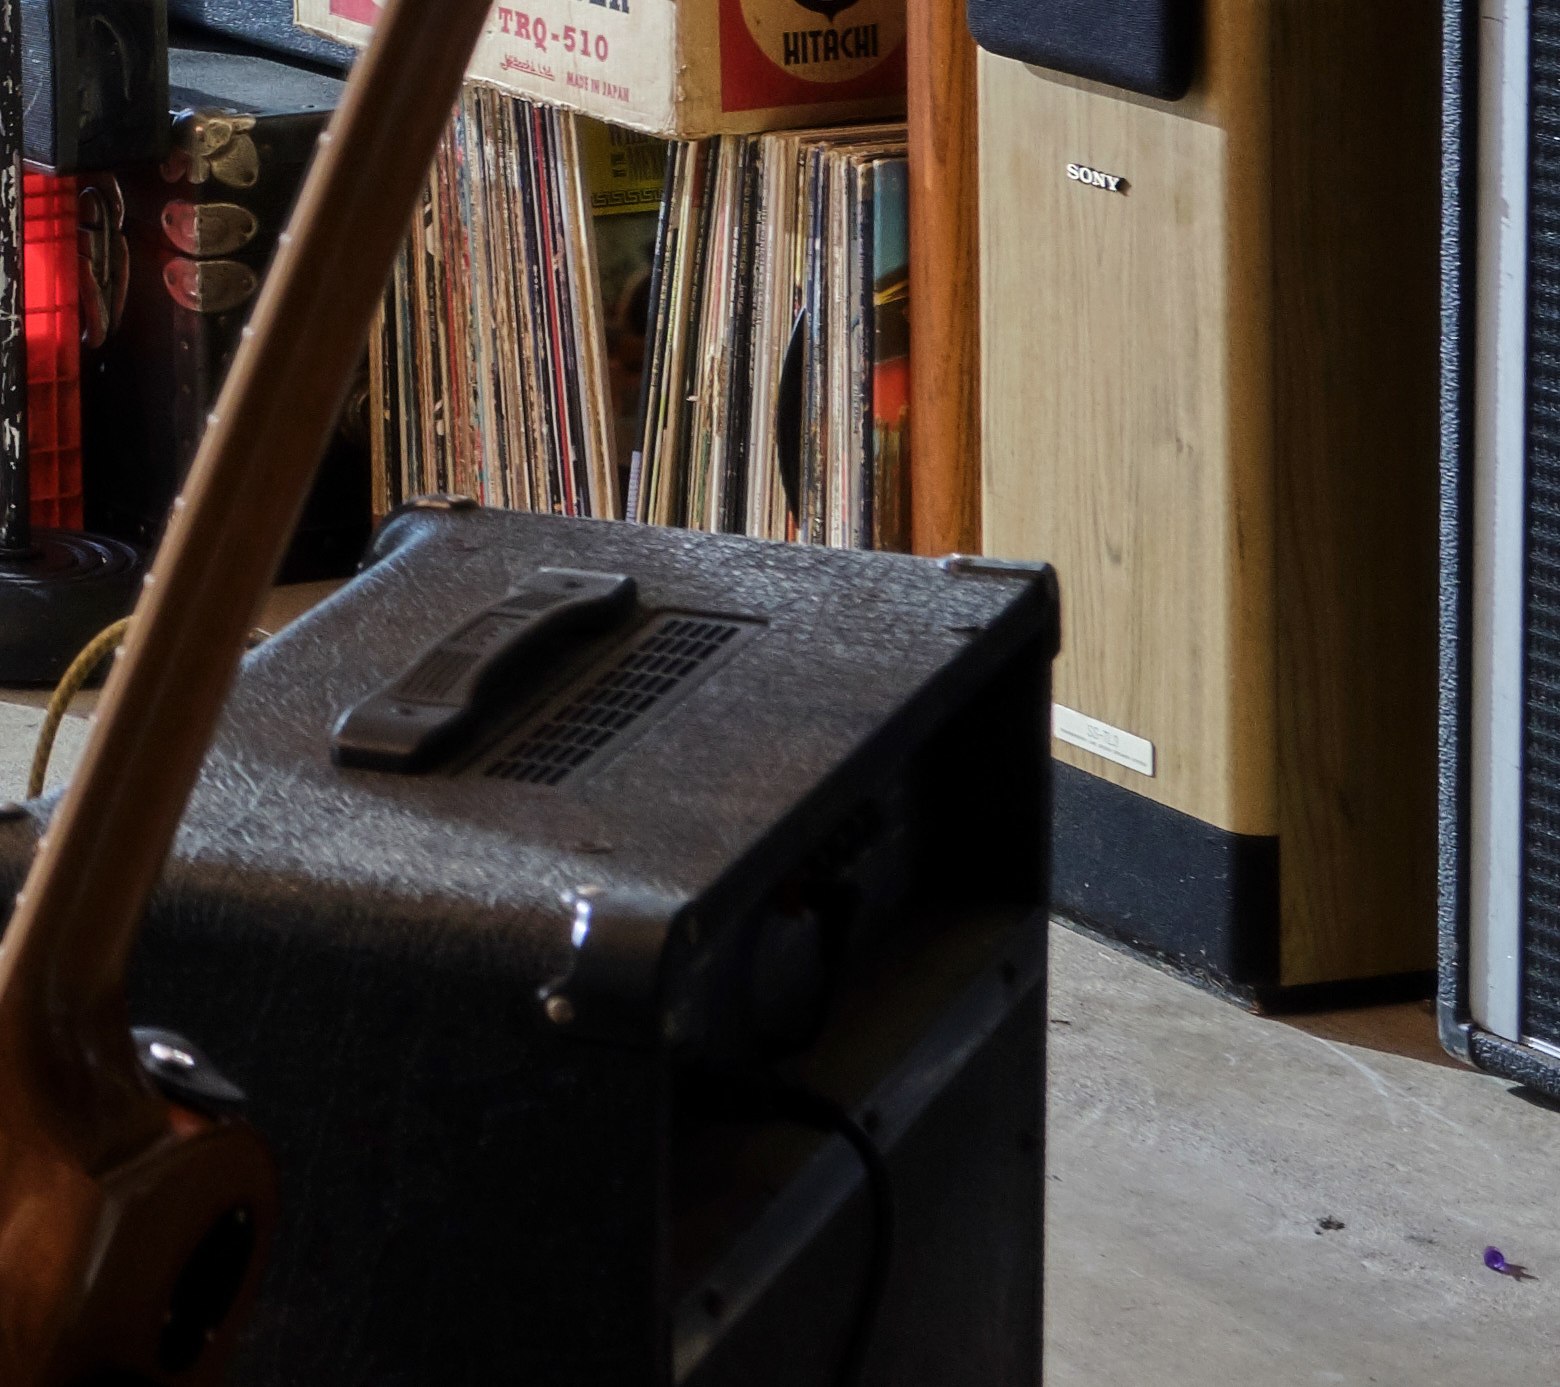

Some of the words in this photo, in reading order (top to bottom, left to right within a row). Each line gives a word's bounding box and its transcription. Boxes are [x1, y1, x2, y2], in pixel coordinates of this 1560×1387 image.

[498, 6, 609, 63] TRQ-510
[782, 22, 879, 67] HITACHI
[566, 70, 587, 89] MADE
[591, 77, 601, 94] IN
[603, 79, 630, 103] JAPAN
[1066, 162, 1121, 192] SONY
